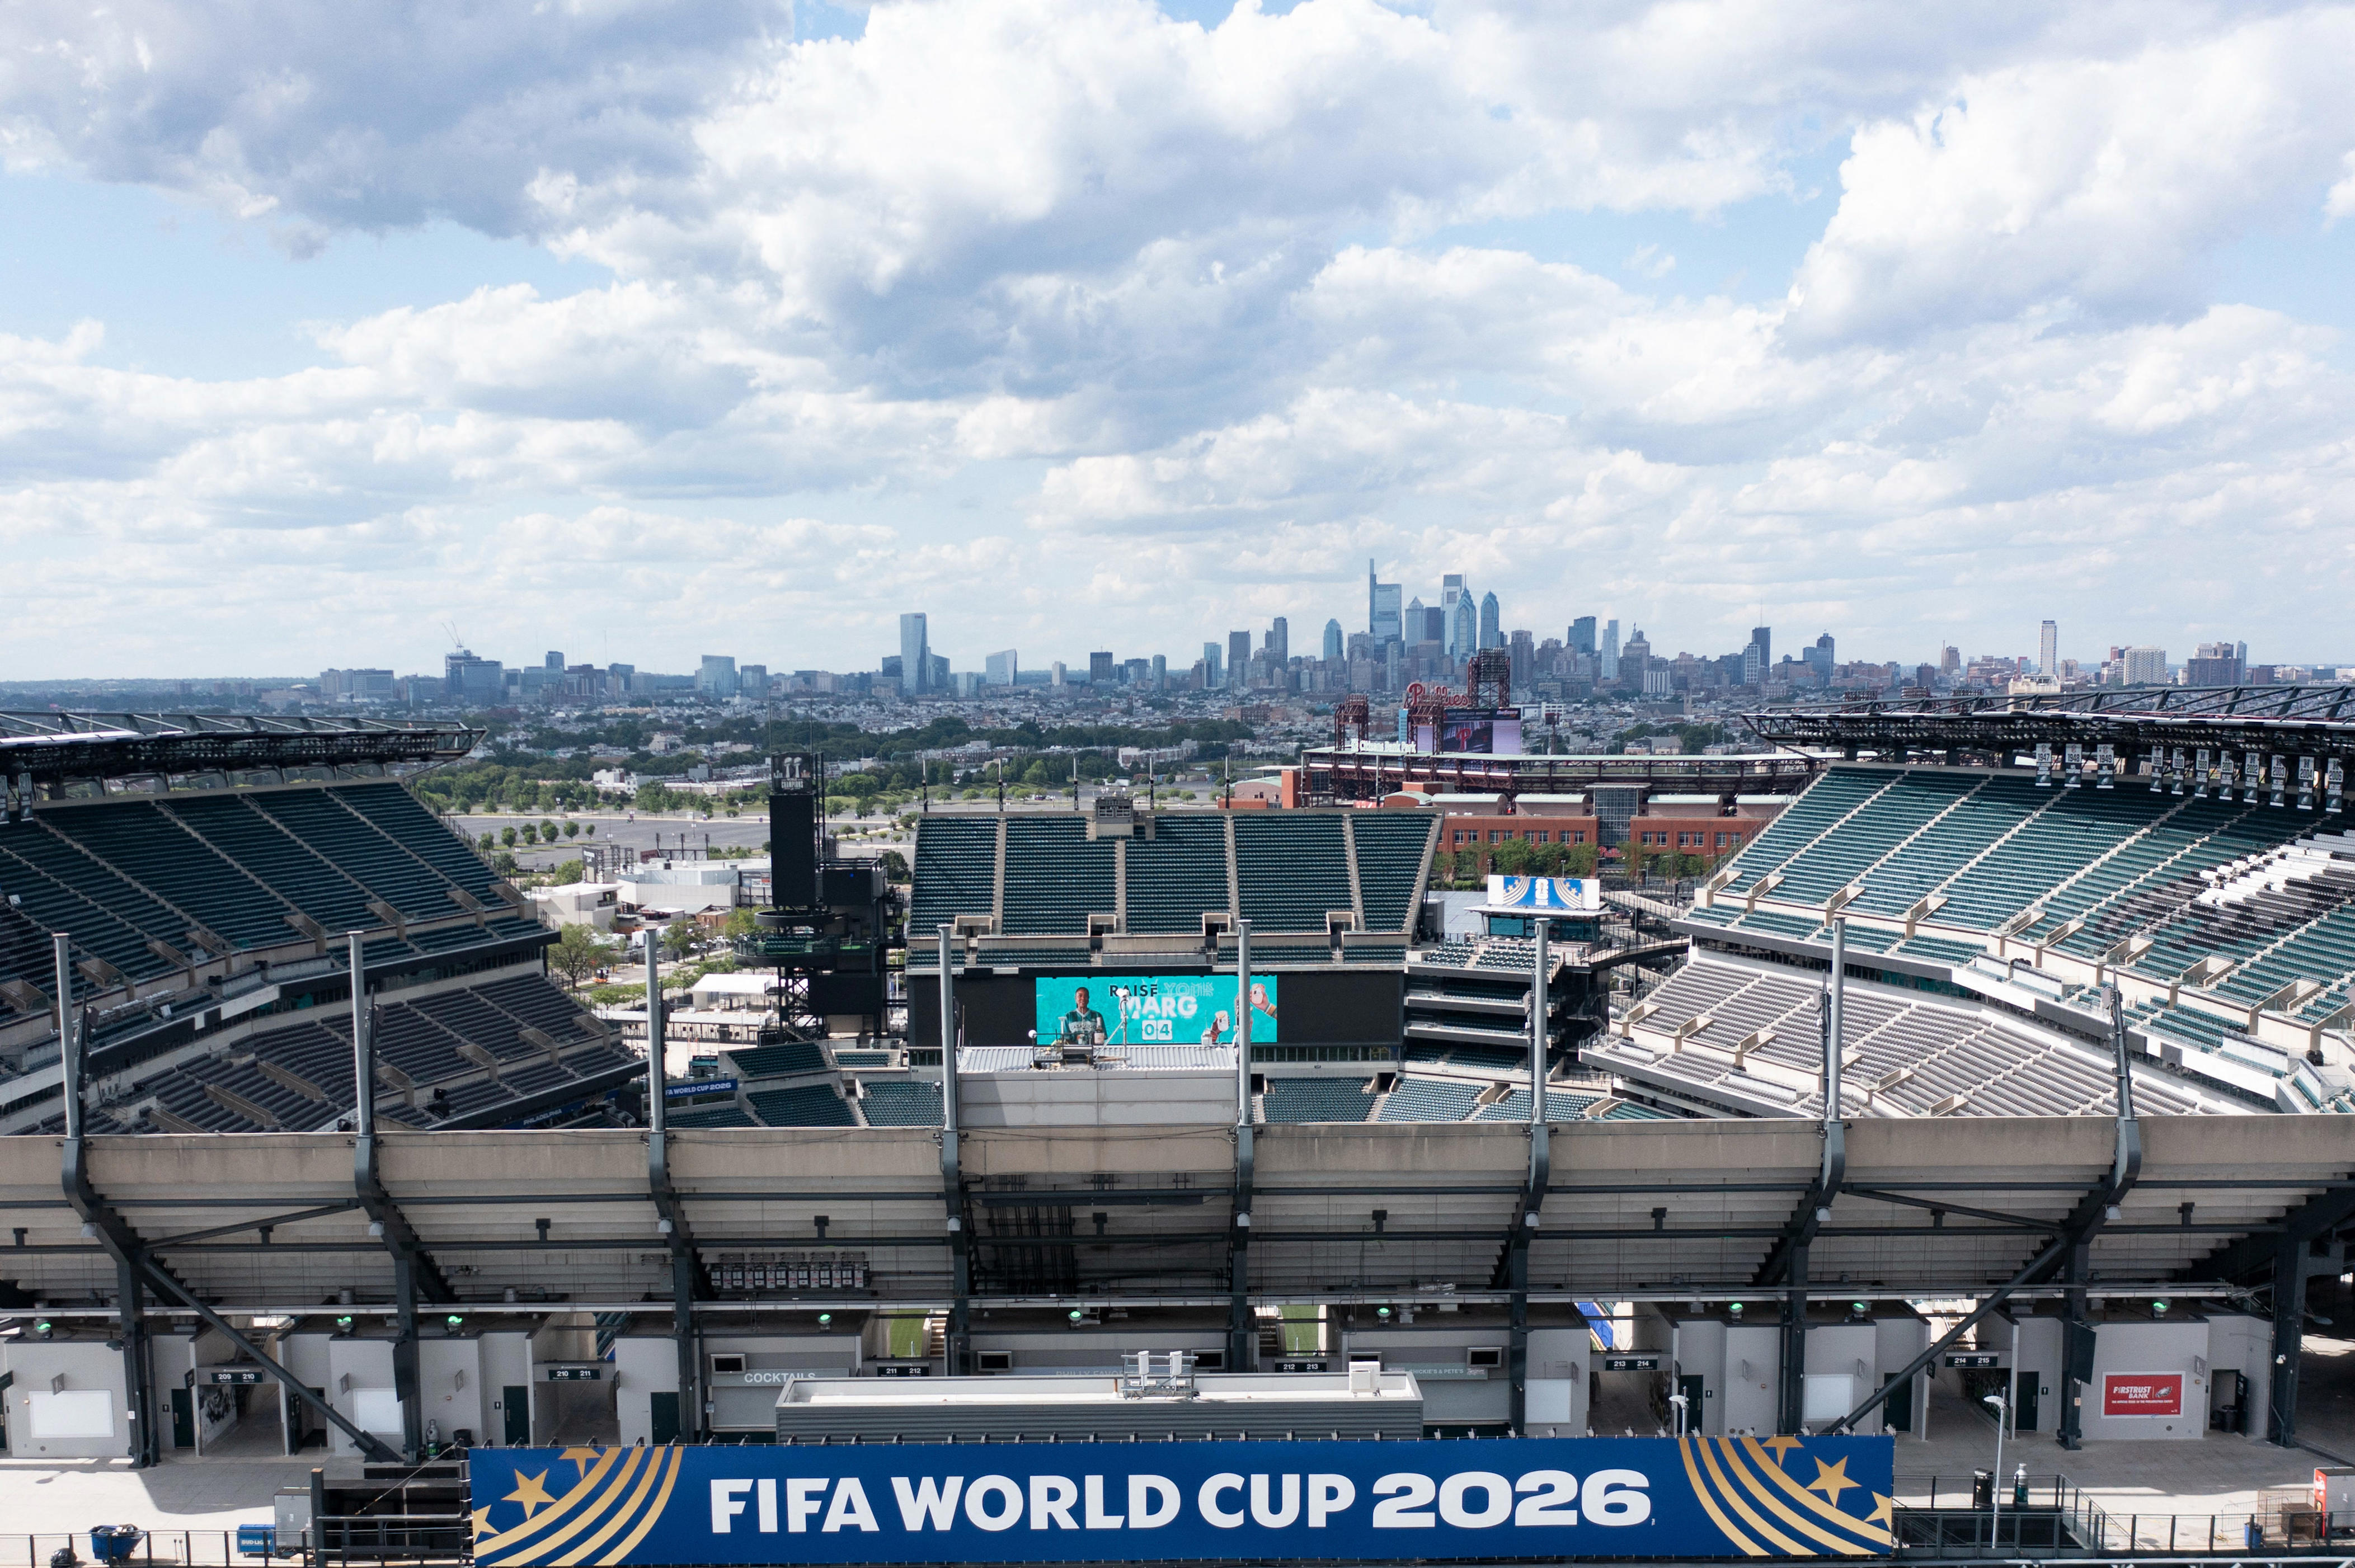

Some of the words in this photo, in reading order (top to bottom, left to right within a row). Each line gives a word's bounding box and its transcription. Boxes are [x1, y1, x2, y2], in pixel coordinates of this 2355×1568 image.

[2038, 753, 2050, 761] 1947
[2067, 754, 2080, 762] 1948
[2099, 754, 2112, 762] 1949
[2300, 769, 2312, 779] 2004
[523, 1109, 562, 1126] PHILADELPHIA
[711, 1478, 880, 1533] FIFA
[891, 1474, 1181, 1532] WORLD
[1198, 1472, 1356, 1528] CUP
[1372, 1468, 1651, 1528] 2026
